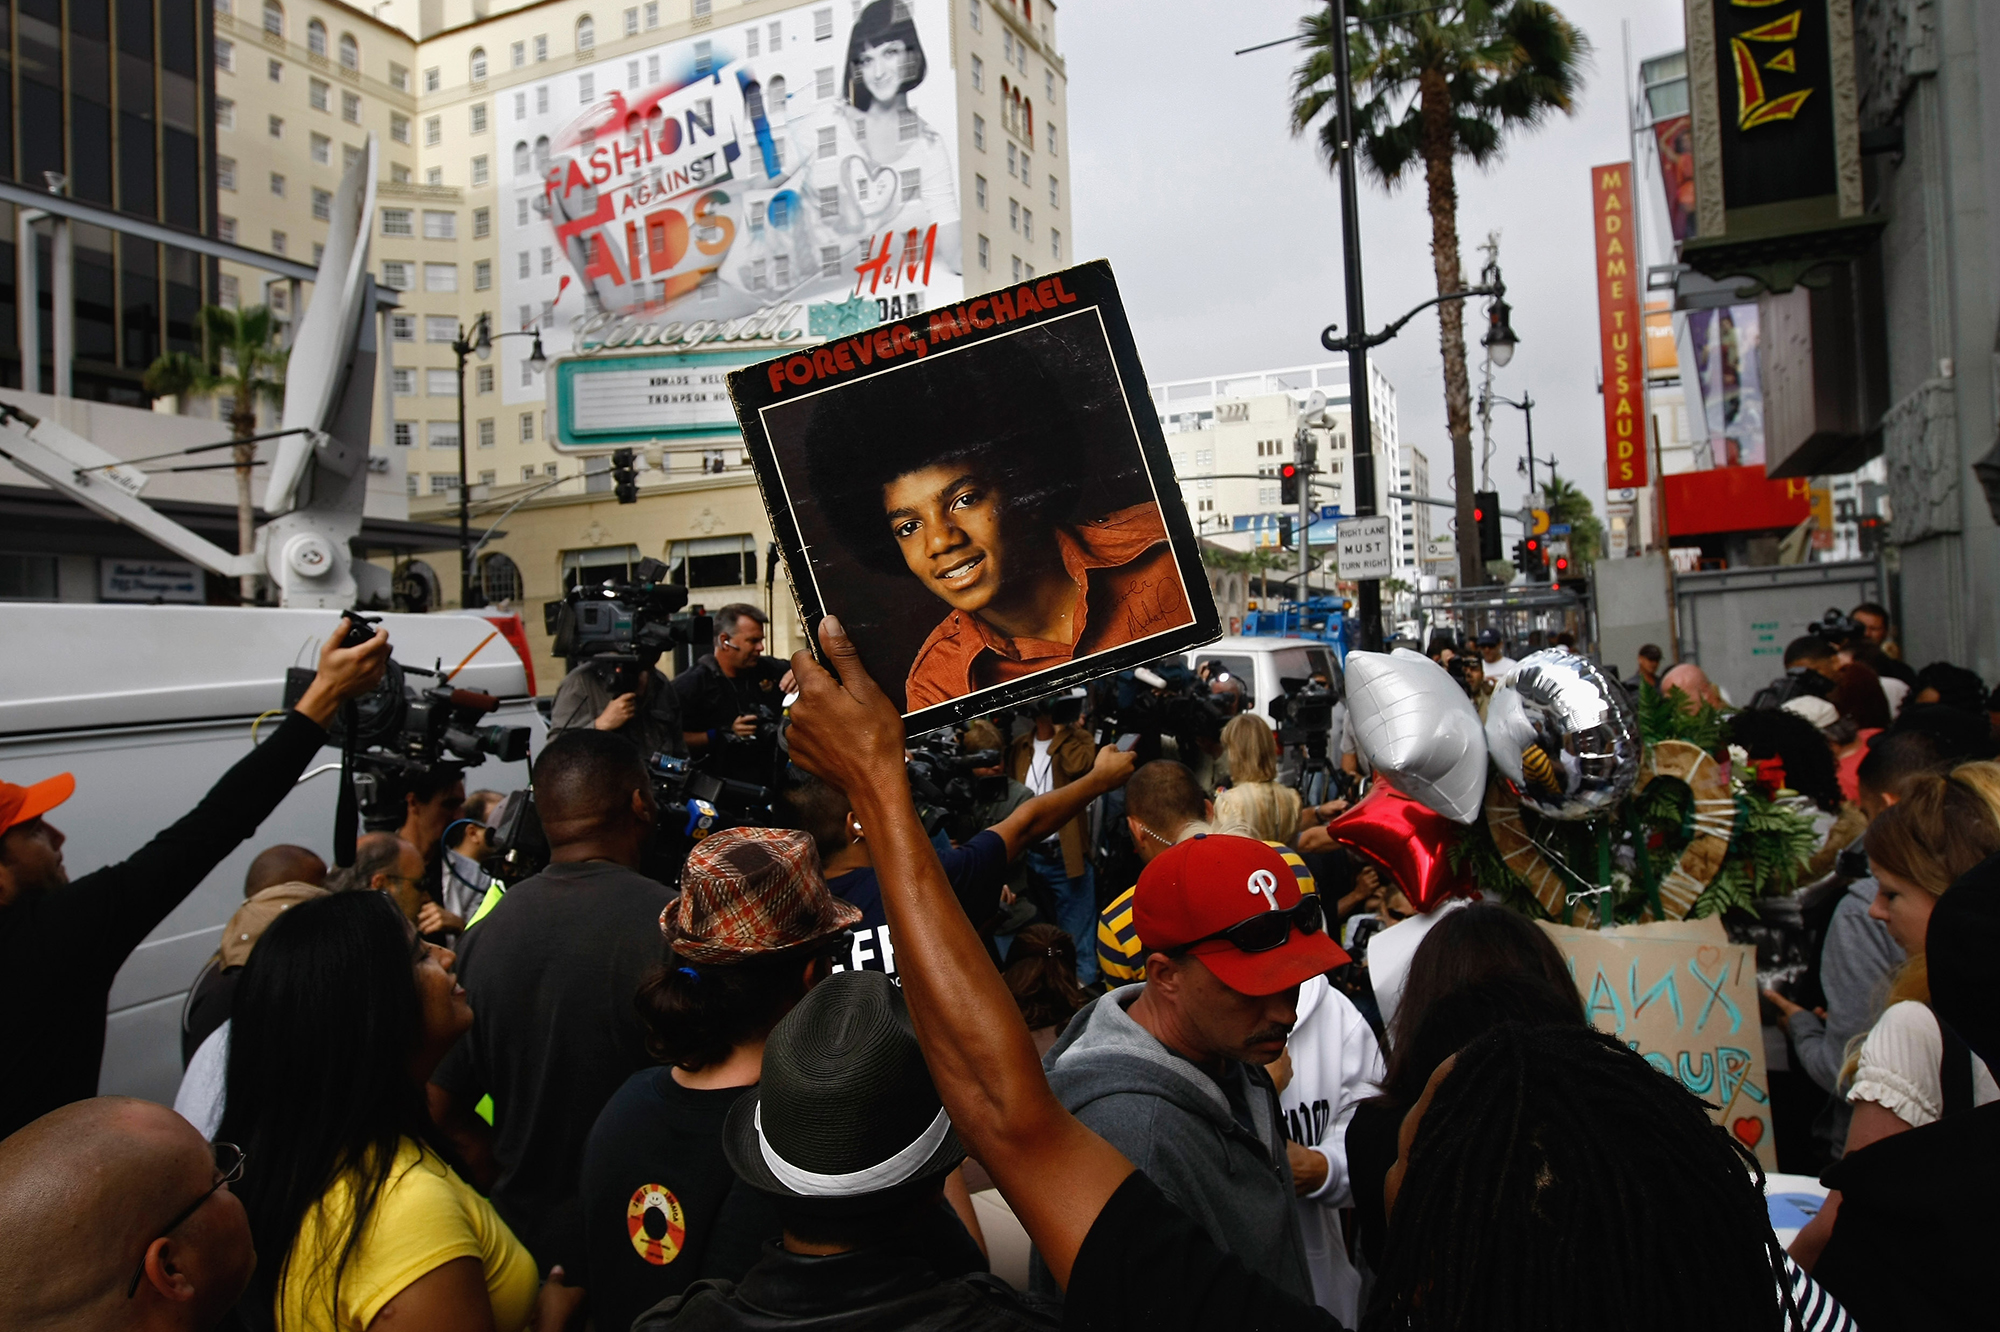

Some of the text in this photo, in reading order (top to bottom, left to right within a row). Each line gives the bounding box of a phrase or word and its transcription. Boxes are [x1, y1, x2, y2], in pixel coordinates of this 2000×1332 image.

[545, 108, 716, 206] FASHION
[622, 152, 716, 214] AGAINST
[583, 190, 735, 287] AIDS
[854, 223, 938, 295] H&M
[1601, 170, 1627, 300] MADAME
[569, 302, 802, 357] Cinegrill
[767, 276, 1078, 393] FOREVER, MICHAEL
[648, 393, 706, 404] THOMPSON
[650, 376, 688, 387] NOMADS
[1612, 310, 1633, 481] TUSSAUDS
[1340, 525, 1386, 539] RIGHT LANE
[1345, 541, 1381, 554] MUST
[1341, 558, 1387, 570] TURN RIGHT
